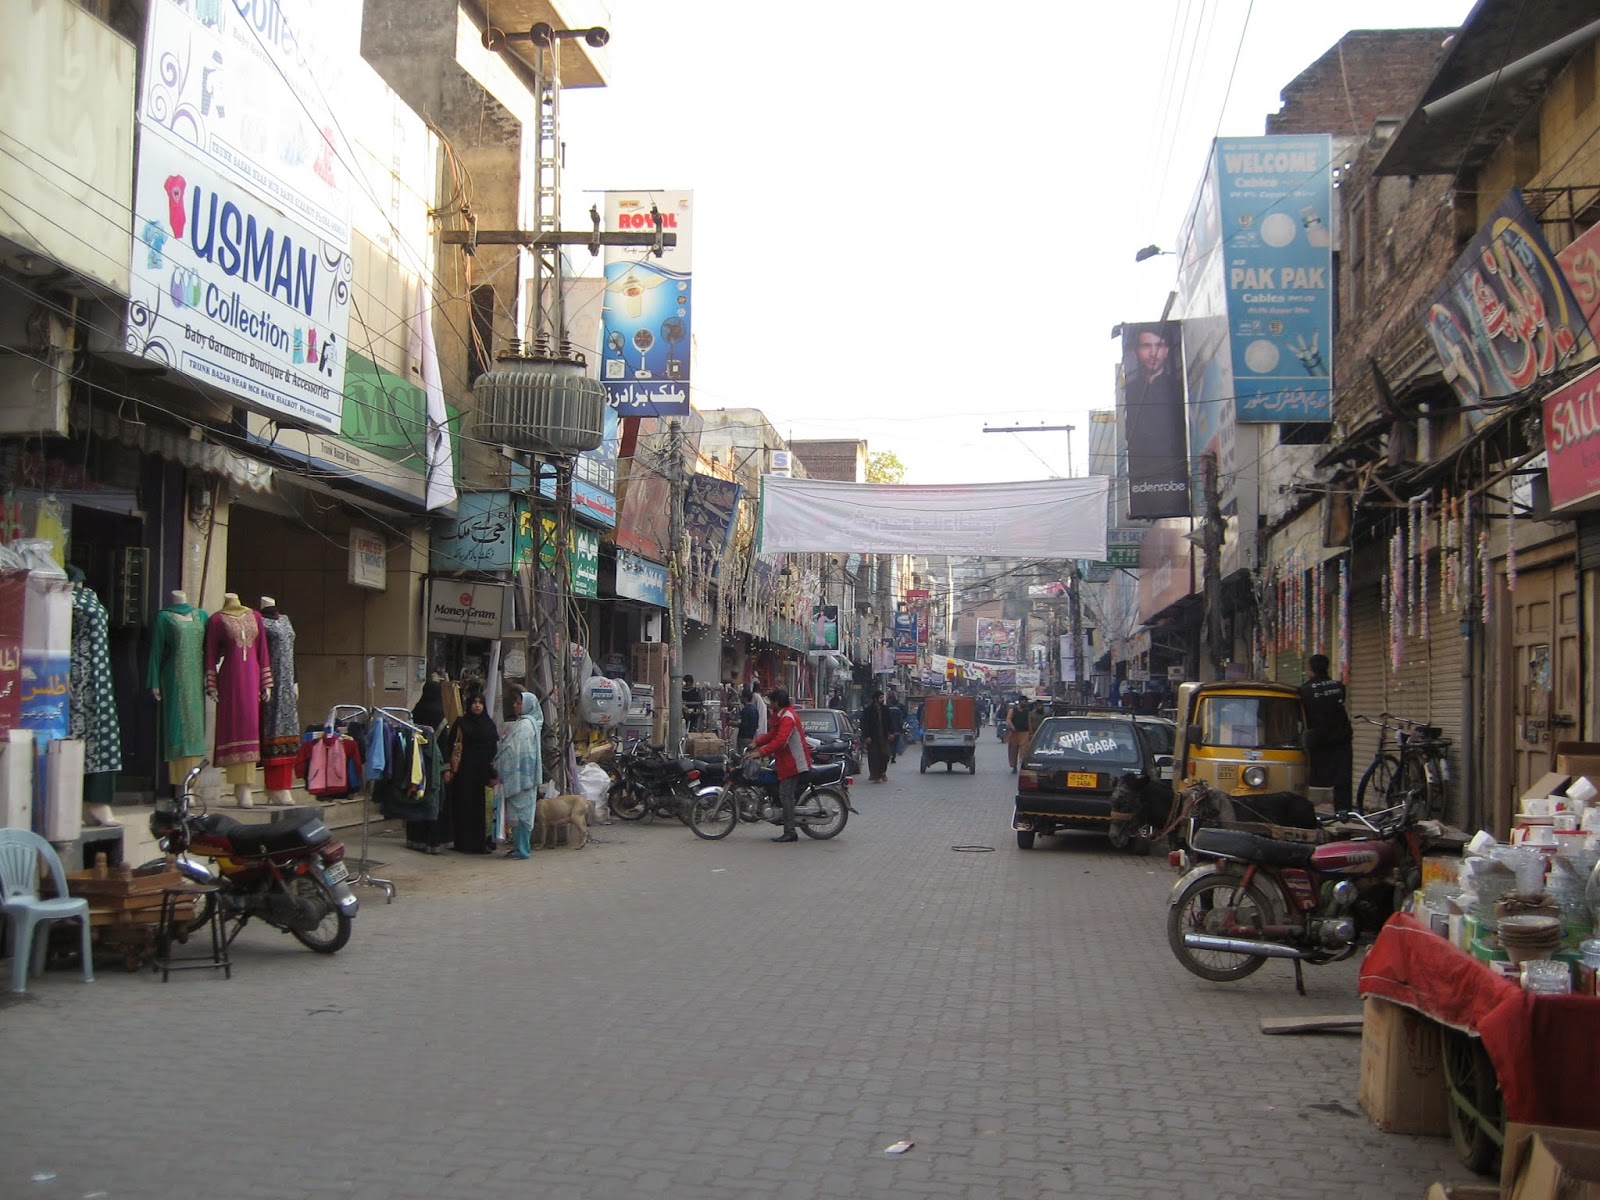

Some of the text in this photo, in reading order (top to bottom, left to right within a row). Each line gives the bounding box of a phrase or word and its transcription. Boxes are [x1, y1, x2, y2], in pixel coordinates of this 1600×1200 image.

[1224, 152, 1317, 174] WELCOME
[191, 185, 317, 316] USMAN
[1231, 267, 1325, 290] PAK PAK
[1243, 293, 1285, 303] Cables
[205, 282, 290, 354] Collection
[185, 324, 330, 400] Baby Garments Boutique & Accessories
[189, 360, 211, 375] TRUNK
[211, 369, 231, 384] BAZAR
[232, 376, 247, 391] NEAR
[248, 383, 260, 395] MCB
[261, 389, 276, 402] BANK
[276, 395, 298, 410] SIALKOT
[650, 385, 686, 404] ملک
[1132, 482, 1186, 493] edenrobe
[434, 604, 496, 620] MoneyGram
[1086, 738, 1118, 755] BABA
